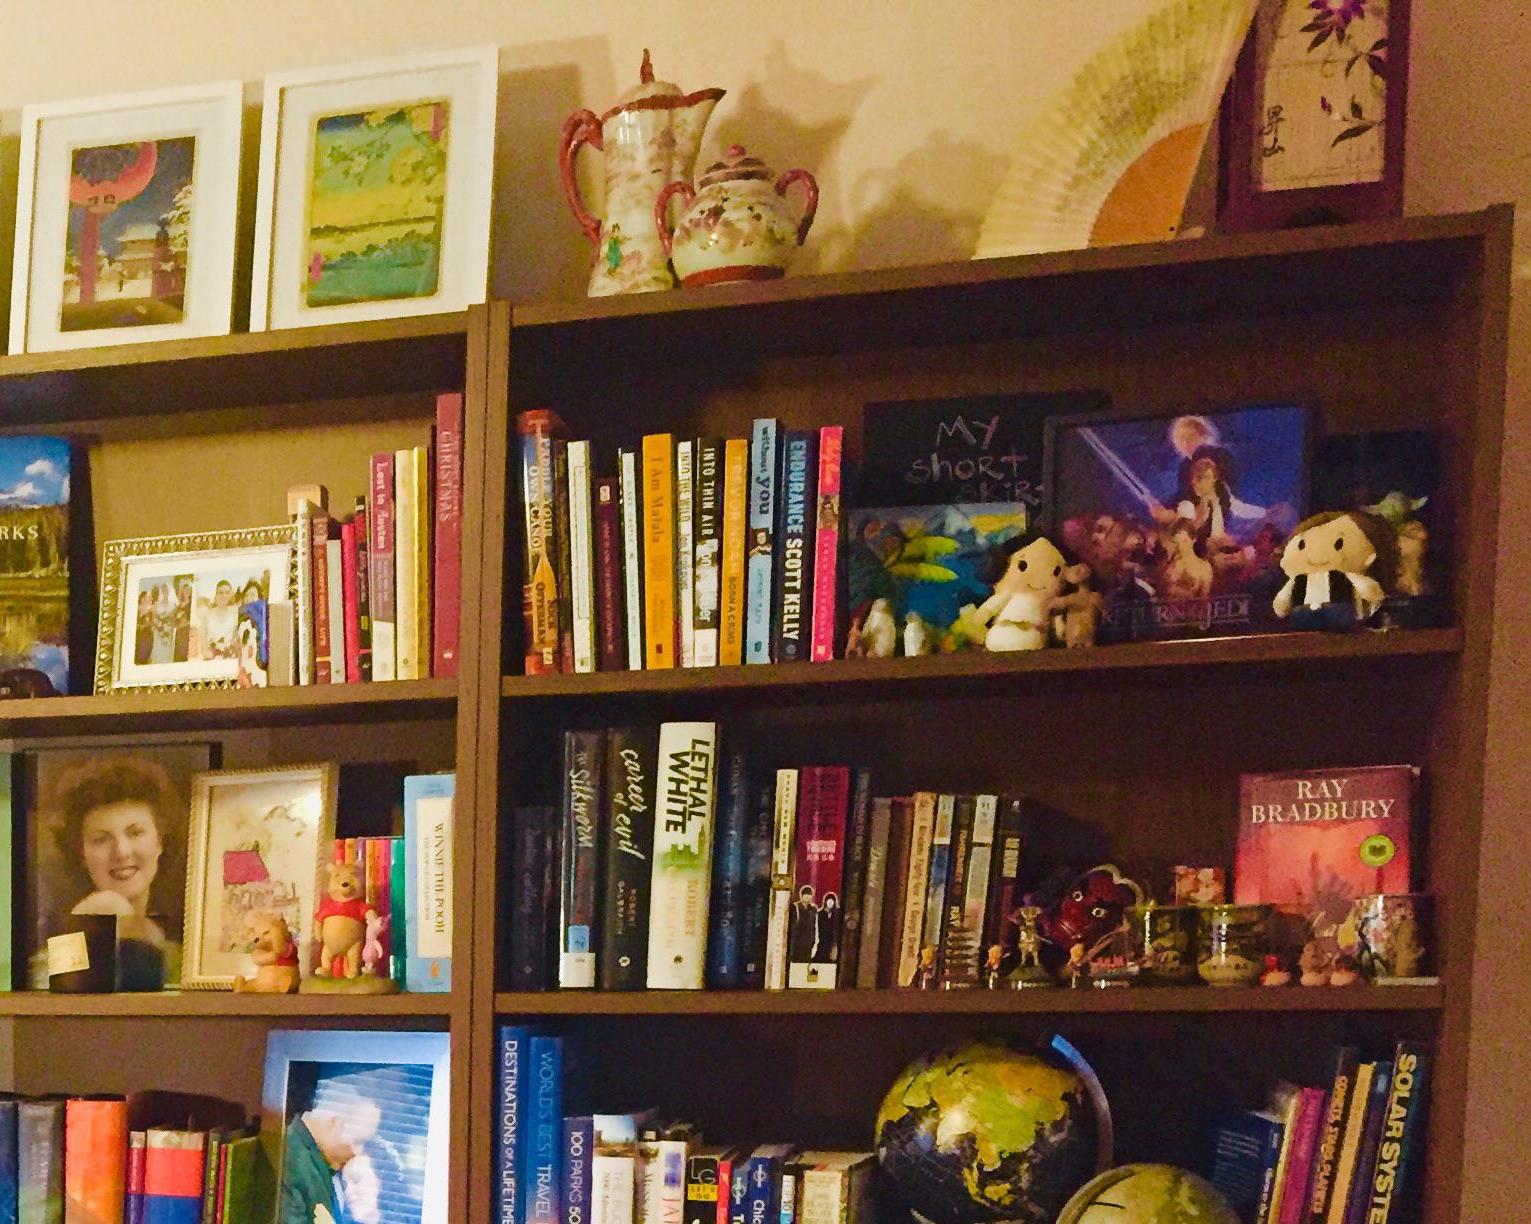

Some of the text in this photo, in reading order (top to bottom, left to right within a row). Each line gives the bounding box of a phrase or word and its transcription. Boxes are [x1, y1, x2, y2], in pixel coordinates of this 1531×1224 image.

[375, 461, 387, 490] Lost
[438, 431, 451, 522] CHRISTMAS
[651, 466, 662, 493] Am
[701, 448, 715, 536] INTO THIN AIR
[757, 476, 771, 515] you
[651, 496, 664, 543] Malala
[782, 440, 806, 640] ENDURANCE SCOTT KELLY
[621, 747, 648, 819] career
[665, 751, 688, 836] WHITE
[686, 738, 710, 823] LETHAL
[1297, 778, 1349, 800] RAY
[616, 810, 646, 861] evil
[1251, 799, 1395, 824] BRADBURY
[434, 822, 445, 934] WINNIE THE POOH
[503, 1040, 517, 1145] DESTINATIONS
[538, 1052, 554, 1120] WORLD'S
[1385, 1053, 1417, 1137] SOLAR
[505, 1147, 514, 1159] OF
[537, 1123, 551, 1159] BEST
[570, 1131, 583, 1156] 100
[536, 1164, 551, 1218] TRAVEL
[569, 1160, 582, 1203] PARKS
